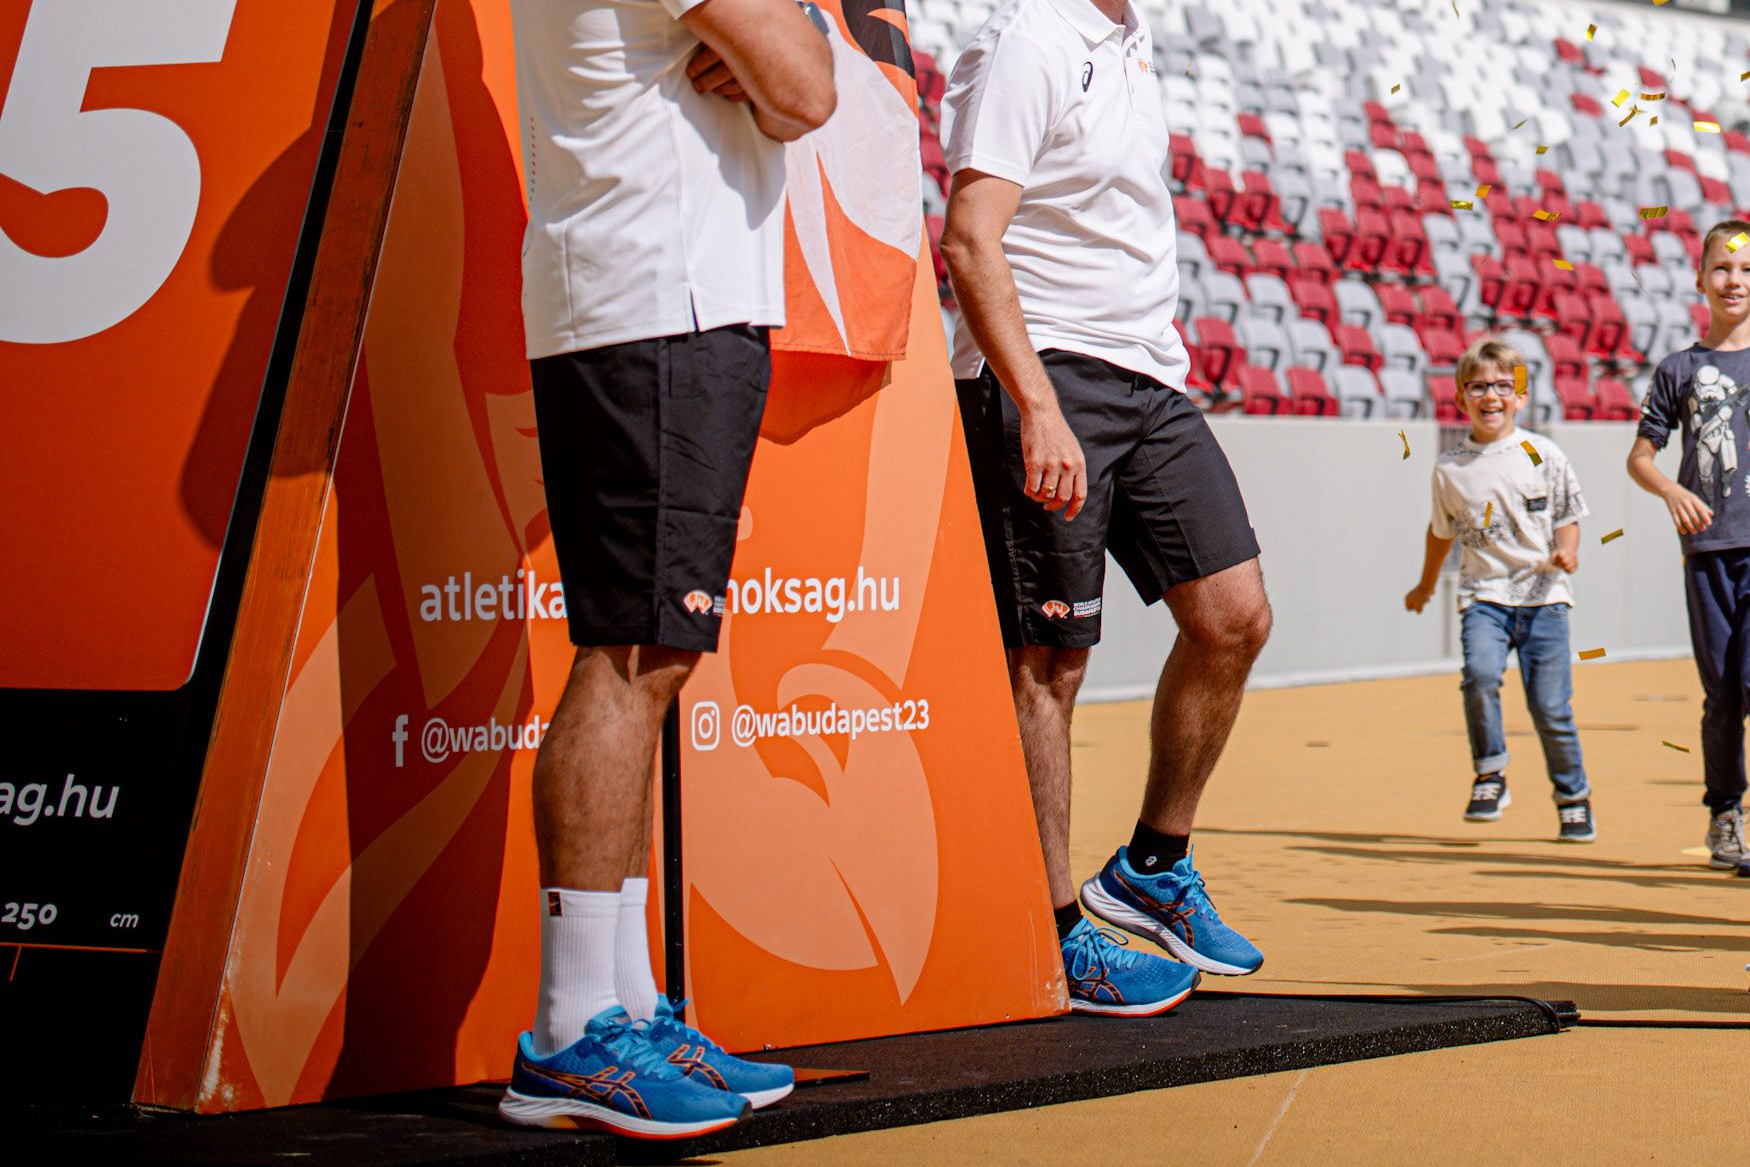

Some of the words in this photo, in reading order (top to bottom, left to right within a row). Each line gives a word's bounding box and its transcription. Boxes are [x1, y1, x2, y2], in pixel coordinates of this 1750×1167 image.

[731, 698, 930, 748] @wabudapest23
[1, 902, 58, 931] 250
[109, 912, 140, 929] cm
